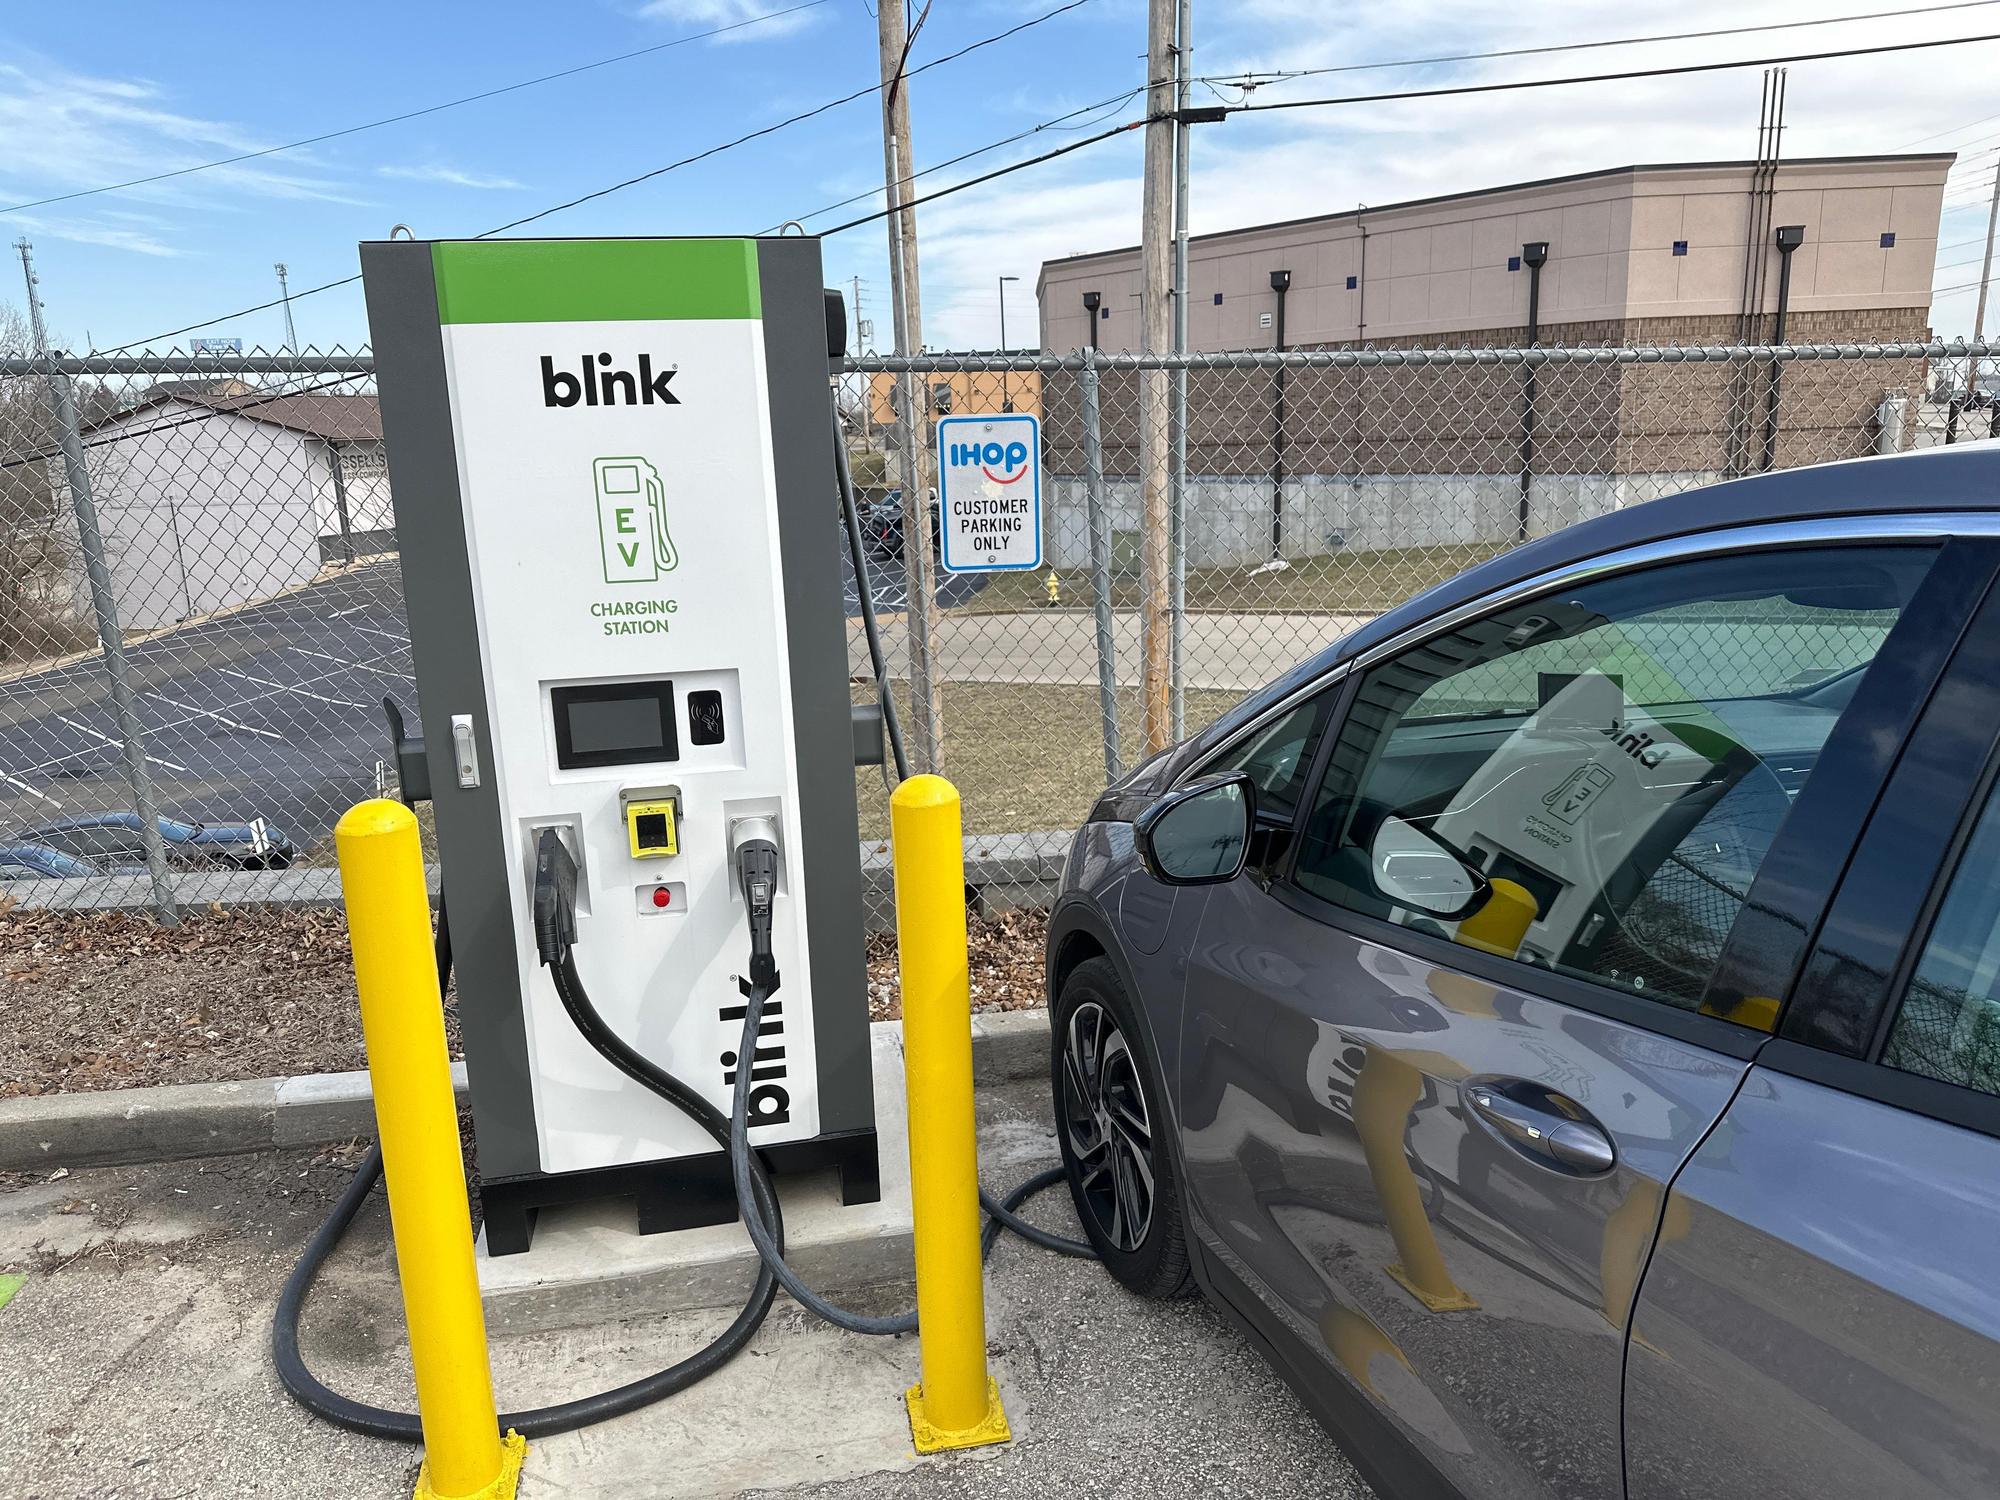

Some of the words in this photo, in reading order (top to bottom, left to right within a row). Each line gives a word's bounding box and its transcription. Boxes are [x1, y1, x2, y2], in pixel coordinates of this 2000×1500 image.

[540, 352, 682, 408] blink
[954, 499, 1029, 516] CUSTOMER
[961, 518, 1022, 534] PARKING
[974, 536, 1010, 551] ONLY
[590, 599, 678, 617] CHARGING
[603, 619, 669, 636] STATION
